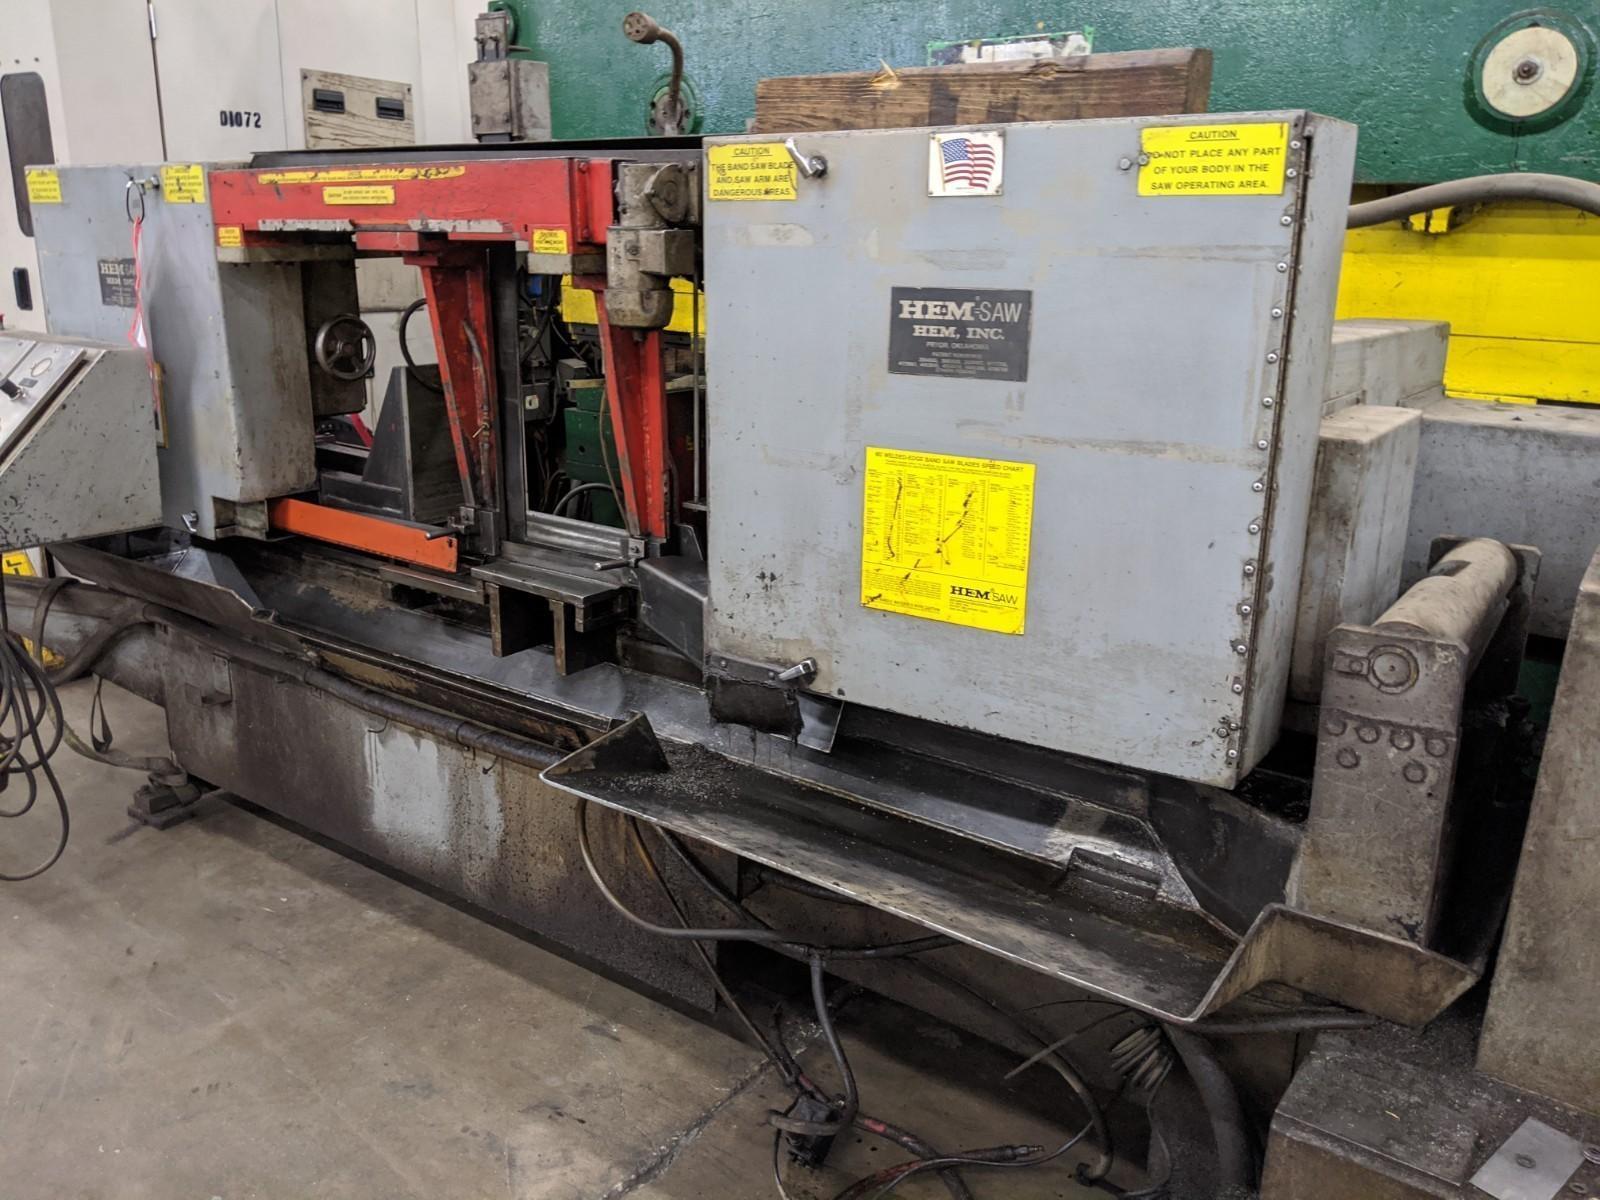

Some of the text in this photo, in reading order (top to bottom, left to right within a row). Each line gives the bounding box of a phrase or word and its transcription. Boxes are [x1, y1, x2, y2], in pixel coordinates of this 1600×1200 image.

[1190, 130, 1238, 139] CAUTION
[734, 147, 770, 155] CAUTION
[1164, 150, 1185, 158] NOT
[1190, 149, 1222, 158] PLACE
[1227, 148, 1249, 157] ANY
[1253, 147, 1281, 156] PART
[727, 163, 749, 171] BAND
[750, 162, 766, 170] SAW
[767, 161, 795, 169] BLADE
[1154, 163, 1270, 174] OF YOUR BODY IN THE
[734, 175, 751, 183] SAW
[754, 175, 771, 183] ARM
[773, 174, 790, 182] ARE
[1151, 180, 1269, 190] SAW OPERATING AREA.
[713, 188, 762, 196] DANGEROUS
[912, 325, 1005, 340] HEM, INC.
